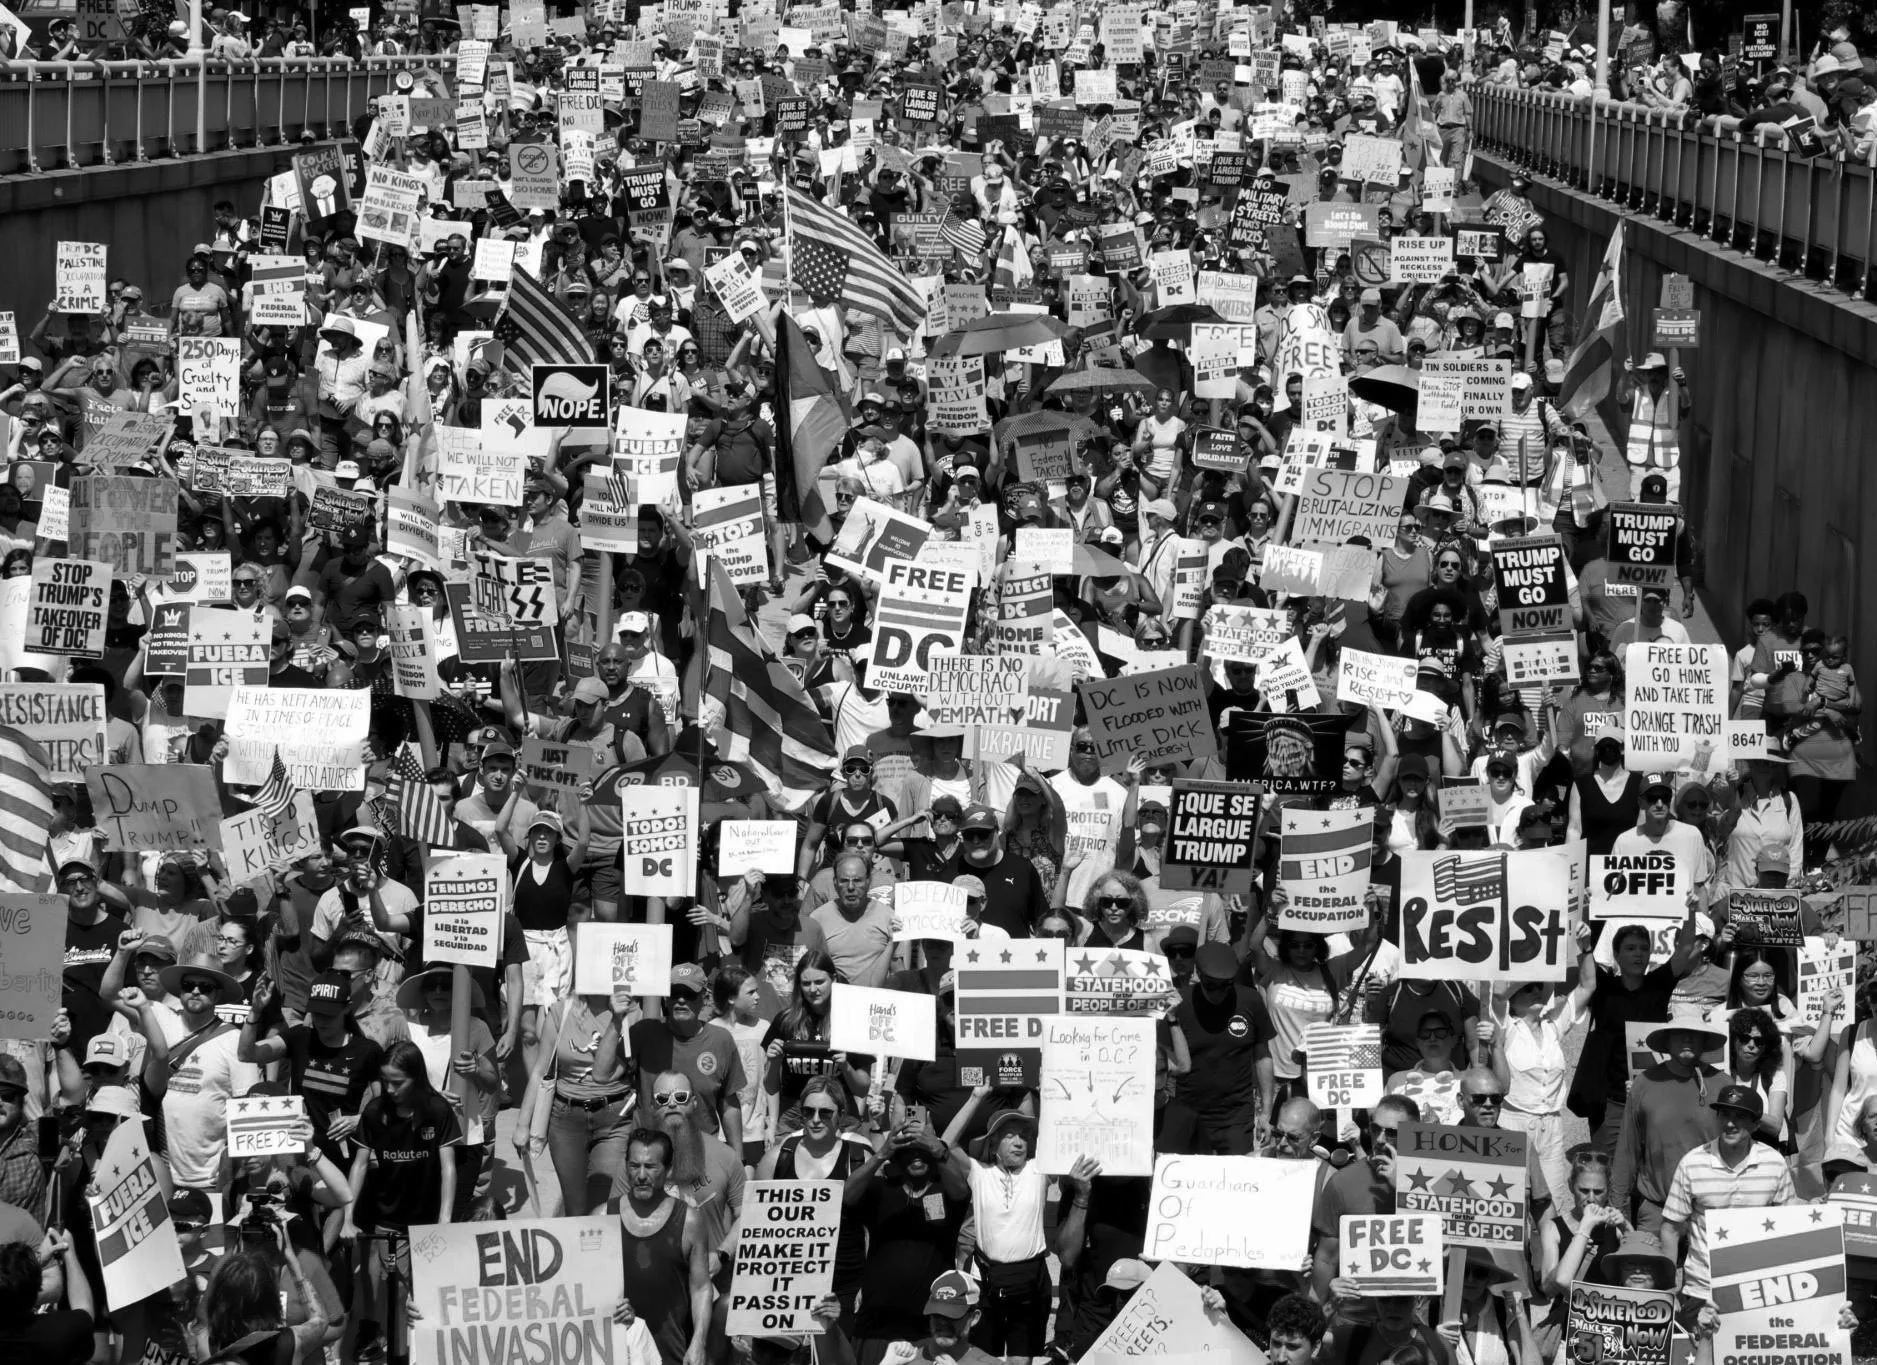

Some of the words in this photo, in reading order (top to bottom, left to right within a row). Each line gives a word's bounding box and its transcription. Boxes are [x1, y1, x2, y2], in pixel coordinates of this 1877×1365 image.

[87, 20, 107, 39] DC
[625, 71, 656, 81] TRUMP
[568, 79, 596, 89] LARGUE
[925, 90, 938, 100] SE
[905, 99, 937, 110] LARGUE
[778, 111, 806, 121] LARGUE
[905, 109, 935, 120] TRUMP
[1232, 157, 1244, 166] SE
[372, 172, 388, 184] NO
[1213, 166, 1243, 176] LARGUE
[624, 172, 664, 186] TRUMP
[935, 178, 966, 192] FREE
[1213, 176, 1241, 185] TRUMP
[1252, 179, 1272, 190] NO
[514, 186, 526, 194] GO
[631, 184, 661, 197] MUST
[640, 197, 656, 208] GO
[1495, 191, 1524, 215] HANDS
[636, 210, 667, 223] NOW!
[84, 245, 100, 255] DC
[1398, 240, 1426, 249] RISE
[1429, 240, 1446, 249] UP
[59, 257, 104, 268] PALESTINE
[1158, 265, 1189, 276] TODOS
[264, 282, 294, 293] END
[1159, 275, 1190, 286] SOMOS
[1167, 286, 1182, 295] DC
[59, 296, 99, 310] CRIME
[1657, 327, 1677, 335] FREE
[1682, 327, 1696, 335] DC
[182, 340, 216, 359] 250
[1443, 363, 1489, 372] SOLDIERS
[1466, 376, 1505, 385] COMING
[935, 385, 978, 402] HAVE
[1463, 391, 1504, 400] FINALLY
[541, 398, 605, 419] NOPE.
[1306, 394, 1346, 409] TODOS
[936, 412, 978, 421] FREEDOM
[944, 421, 978, 429] SAFETY
[1317, 420, 1335, 432] DC
[1210, 432, 1235, 441] FAITH
[620, 438, 678, 454] FUERA
[1211, 444, 1232, 452] LOVE
[447, 452, 465, 465] WE
[498, 456, 520, 467] NOT
[638, 457, 661, 474] ICE
[1197, 454, 1244, 464] SOLIDARITY
[444, 473, 520, 502] TAKEN
[1312, 472, 1393, 501] STOP
[1299, 498, 1400, 518] BRUTALIZING
[615, 517, 627, 527] US
[1613, 513, 1675, 530] TRUMP
[1617, 530, 1668, 546] MUST
[1494, 548, 1560, 568] TRUMP
[1628, 546, 1656, 562] GO
[52, 563, 93, 585] STOP
[890, 564, 965, 594] FREE
[1503, 567, 1555, 586] MUST
[1617, 566, 1667, 583] NOW!
[38, 582, 103, 607] TRUMP'S
[1518, 587, 1546, 604] GO
[34, 608, 101, 629] TAKEOVER
[1512, 610, 1563, 630] NOW!
[41, 627, 60, 646] OF
[62, 628, 89, 649] DC!
[996, 627, 1043, 641] HOME
[193, 646, 266, 662] FUERA
[1648, 646, 1682, 665] FREE
[1689, 647, 1708, 665] DC
[933, 657, 975, 672] THERE
[999, 657, 1022, 672] NO
[210, 668, 245, 686] ICE
[931, 671, 1026, 693] DEMOCRACY
[1652, 667, 1670, 683] GO
[1089, 688, 1125, 709] DC
[1158, 672, 1198, 691] NOW
[1635, 686, 1658, 703] AND
[1662, 687, 1691, 704] TAKE
[1694, 687, 1715, 704] THE
[940, 692, 1015, 706] WITHOUT
[1102, 708, 1167, 731] FLOODED
[1631, 711, 1677, 734] ORANGE
[1152, 721, 1205, 745] DICK
[1732, 733, 1764, 747] 8647
[541, 748, 568, 763] JUST
[526, 765, 555, 781] FUCK
[1230, 795, 1255, 816] SE
[630, 816, 686, 834] TODOS
[1173, 816, 1251, 840] LARGUE
[242, 821, 316, 873] KINGS!
[629, 836, 686, 854] SOMOS
[1174, 840, 1247, 864] TRUMP
[642, 858, 672, 877] DC
[1299, 855, 1355, 879] END
[1604, 856, 1676, 870] HANDS
[430, 880, 496, 894] TENEMOS
[1319, 884, 1337, 894] the
[429, 899, 495, 912] DERECHO
[1294, 896, 1357, 908] FEDERAL
[1285, 909, 1364, 921] OCCUPATION
[434, 923, 488, 936] LIBERTAD
[433, 939, 488, 952] SEGURIDAD
[612, 966, 636, 982] DC
[310, 984, 340, 998] SPIRIT
[1073, 978, 1167, 993] STATEHOOD
[1072, 998, 1125, 1011] PEOPLE
[1127, 999, 1145, 1011] OF
[869, 1027, 895, 1042] DC
[959, 1018, 1019, 1038] FREE
[787, 1057, 819, 1075] FREE
[1317, 1073, 1365, 1090] FREE
[1328, 1091, 1351, 1106] DC
[235, 1132, 272, 1152] FREE
[1413, 1130, 1503, 1158] HONK
[1503, 1144, 1523, 1155] for
[383, 1150, 429, 1160] Rakuten
[1160, 1159, 1260, 1194] Guardians
[98, 1163, 157, 1228] FUERA
[755, 1189, 808, 1203] THIS
[812, 1187, 831, 1202] IS
[1405, 1193, 1516, 1217] STATEHOOD
[767, 1205, 815, 1222] OUR
[121, 1208, 154, 1251] ICE
[742, 1226, 837, 1239] DEMOCRACY
[1348, 1218, 1424, 1249] FREE
[1468, 1224, 1488, 1238] OF
[1492, 1224, 1515, 1240] DC
[475, 1228, 563, 1287] END
[738, 1243, 802, 1258] MAKE
[808, 1242, 830, 1258] IT
[736, 1260, 830, 1275] PROTECT
[1369, 1247, 1412, 1273] DC
[1739, 1271, 1819, 1311] END
[437, 1283, 596, 1326] FEDERAL
[732, 1295, 790, 1310] PASS
[762, 1314, 794, 1329] ON
[1768, 1316, 1794, 1328] the
[436, 1316, 614, 1365] INVASION
[1735, 1332, 1830, 1350] FEDERAL
[1723, 1353, 1842, 1365] OCCUPATION
